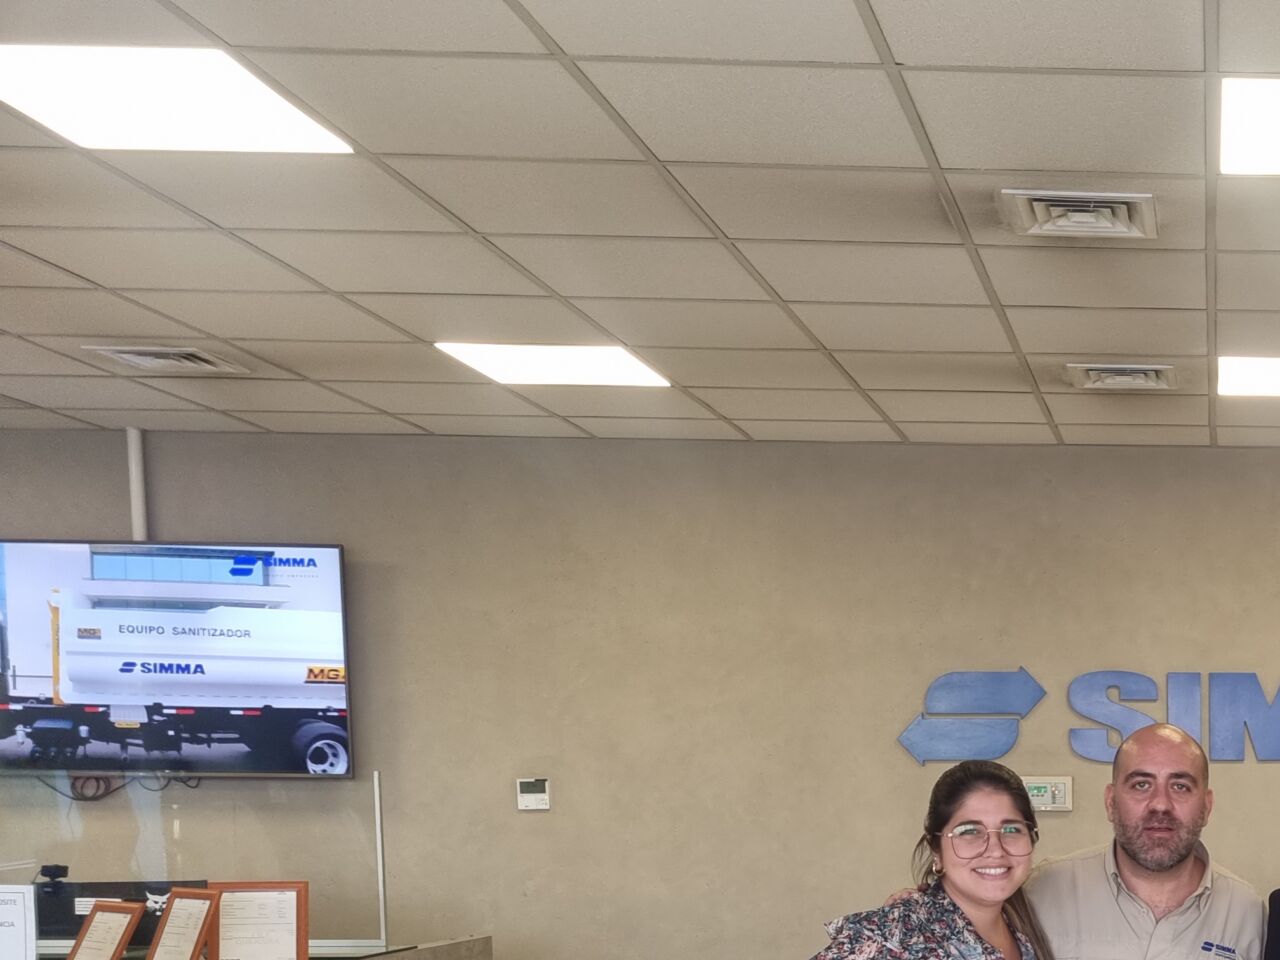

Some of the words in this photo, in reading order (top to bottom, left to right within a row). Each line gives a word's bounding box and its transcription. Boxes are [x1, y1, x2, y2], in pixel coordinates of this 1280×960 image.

[264, 556, 318, 568] SIMMA
[118, 624, 165, 635] EQUIPO
[172, 626, 252, 638] SANITIZADOR
[140, 662, 206, 675] SIMMA
